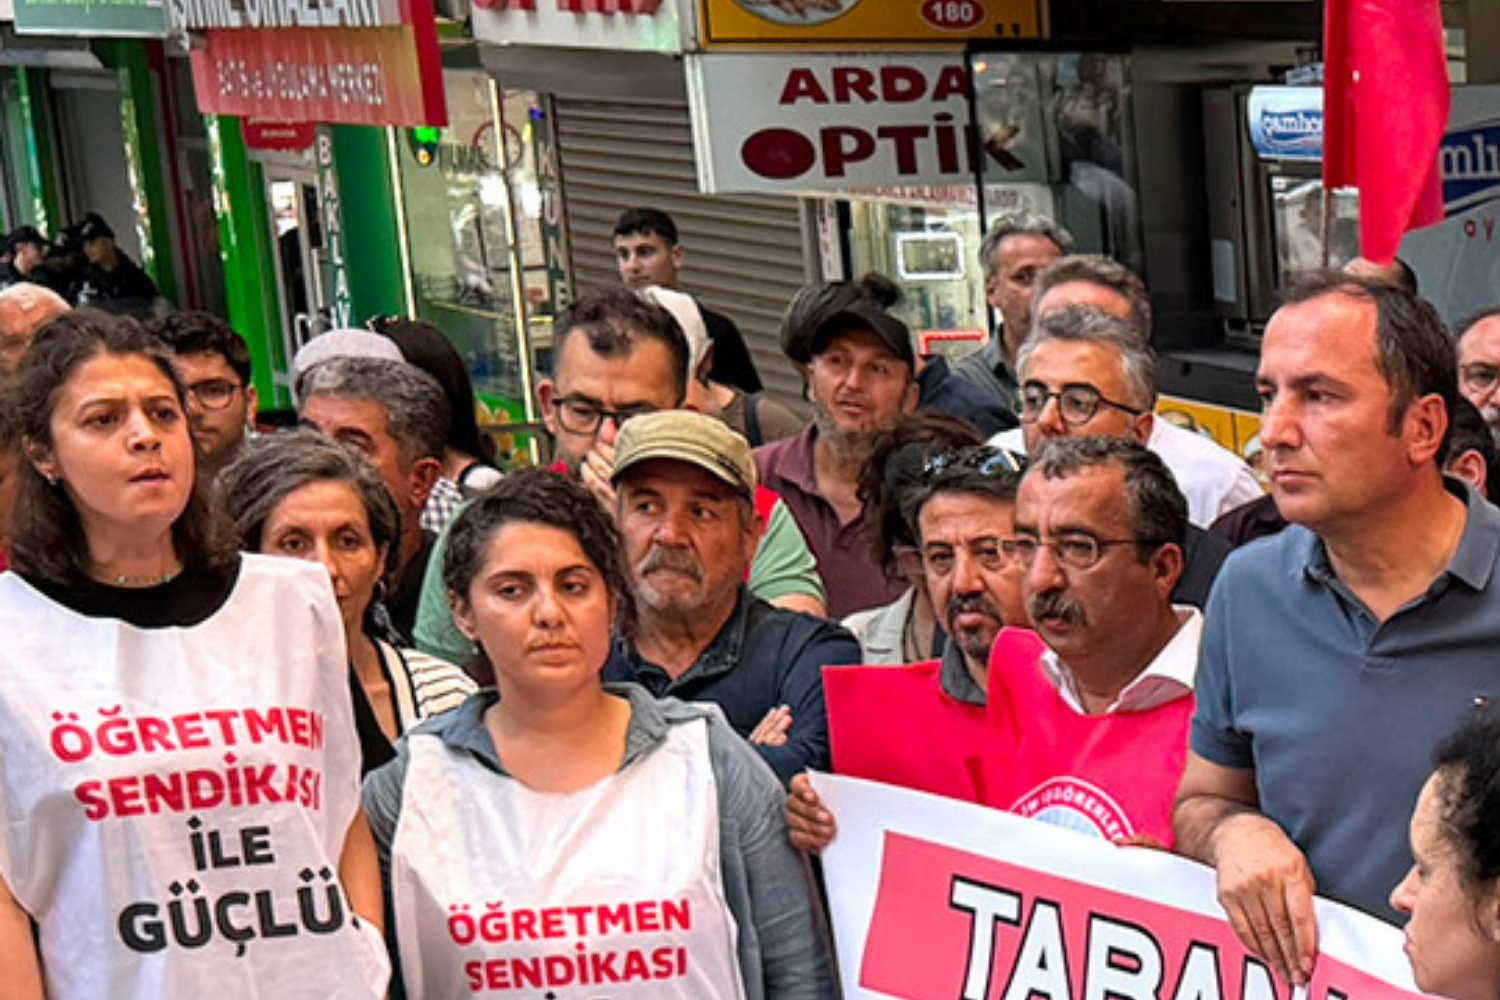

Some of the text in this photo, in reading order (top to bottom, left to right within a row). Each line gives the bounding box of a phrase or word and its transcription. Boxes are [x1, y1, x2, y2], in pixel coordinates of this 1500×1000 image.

[931, 3, 973, 21] 180
[778, 66, 969, 106] ARDA
[740, 112, 1025, 180] OPTİK
[50, 704, 324, 764] ÖĞRETMEN
[187, 816, 275, 871] İLE
[118, 866, 361, 957] GÜÇLÜ
[447, 898, 692, 946] ÖĞRETMEN
[464, 942, 688, 991] SENDİKASI
